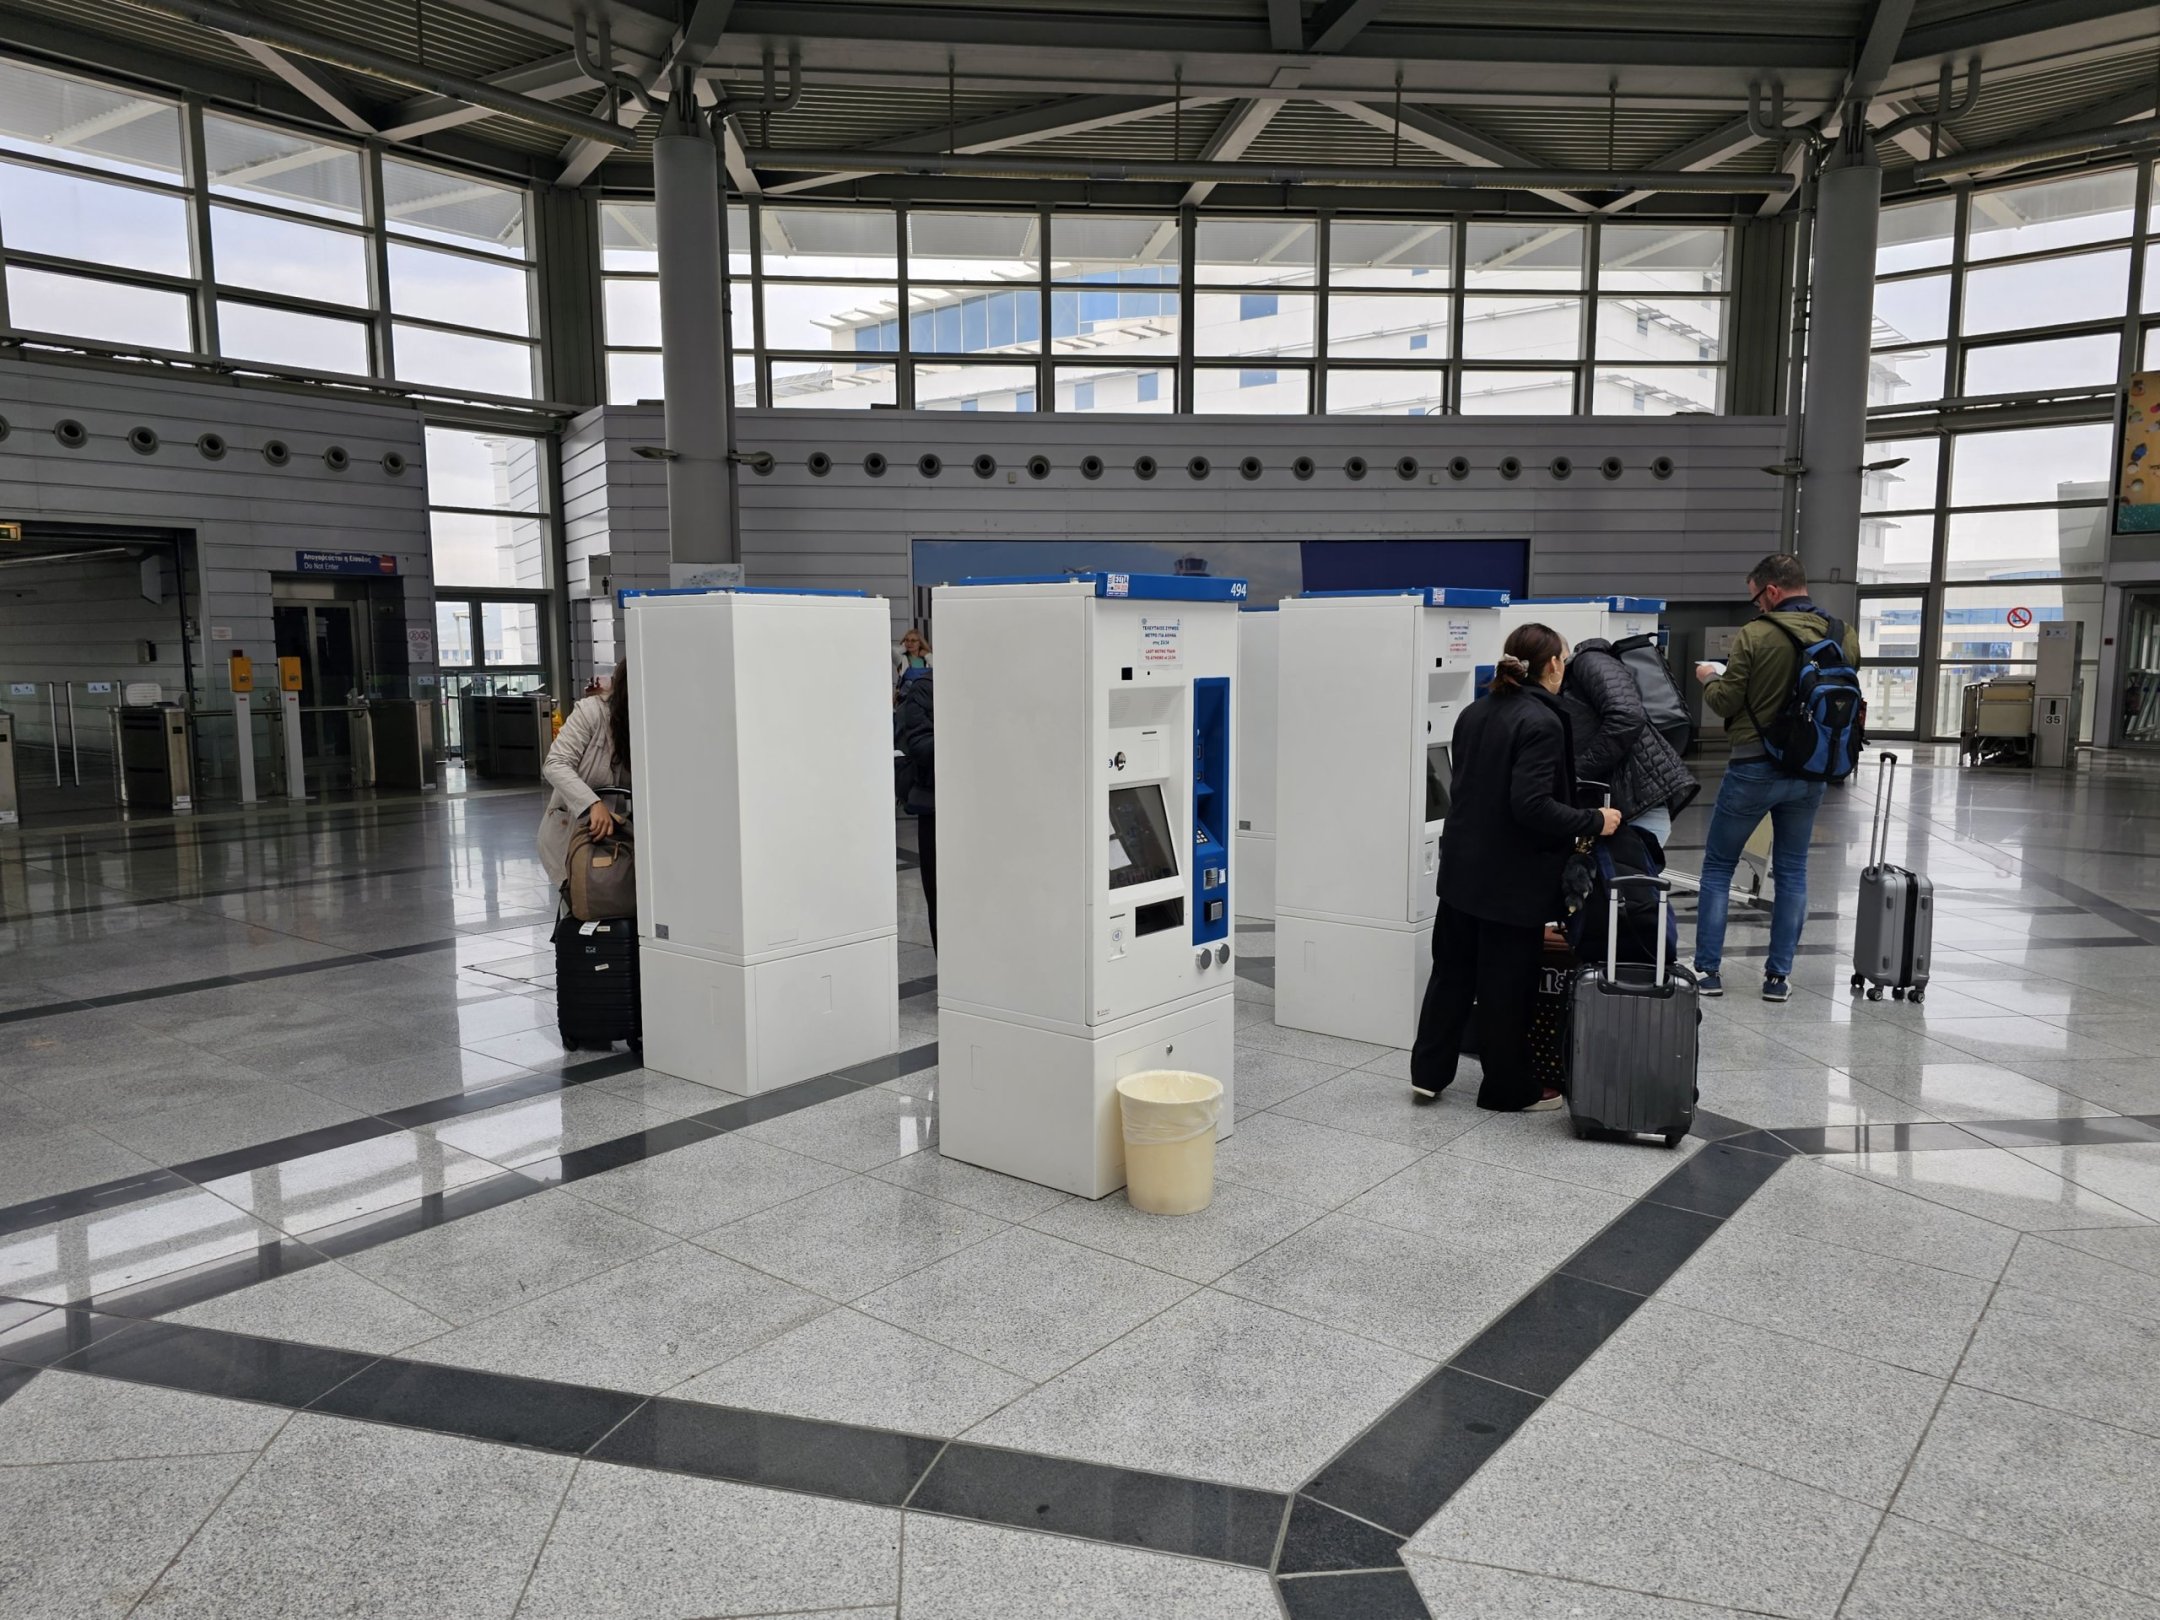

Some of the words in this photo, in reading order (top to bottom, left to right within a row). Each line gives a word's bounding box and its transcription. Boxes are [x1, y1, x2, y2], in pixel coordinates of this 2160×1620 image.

[304, 562, 313, 570] Do
[313, 563, 324, 571] Not
[325, 563, 339, 571] Enter
[1231, 583, 1247, 597] 494
[2046, 715, 2061, 724] 35
